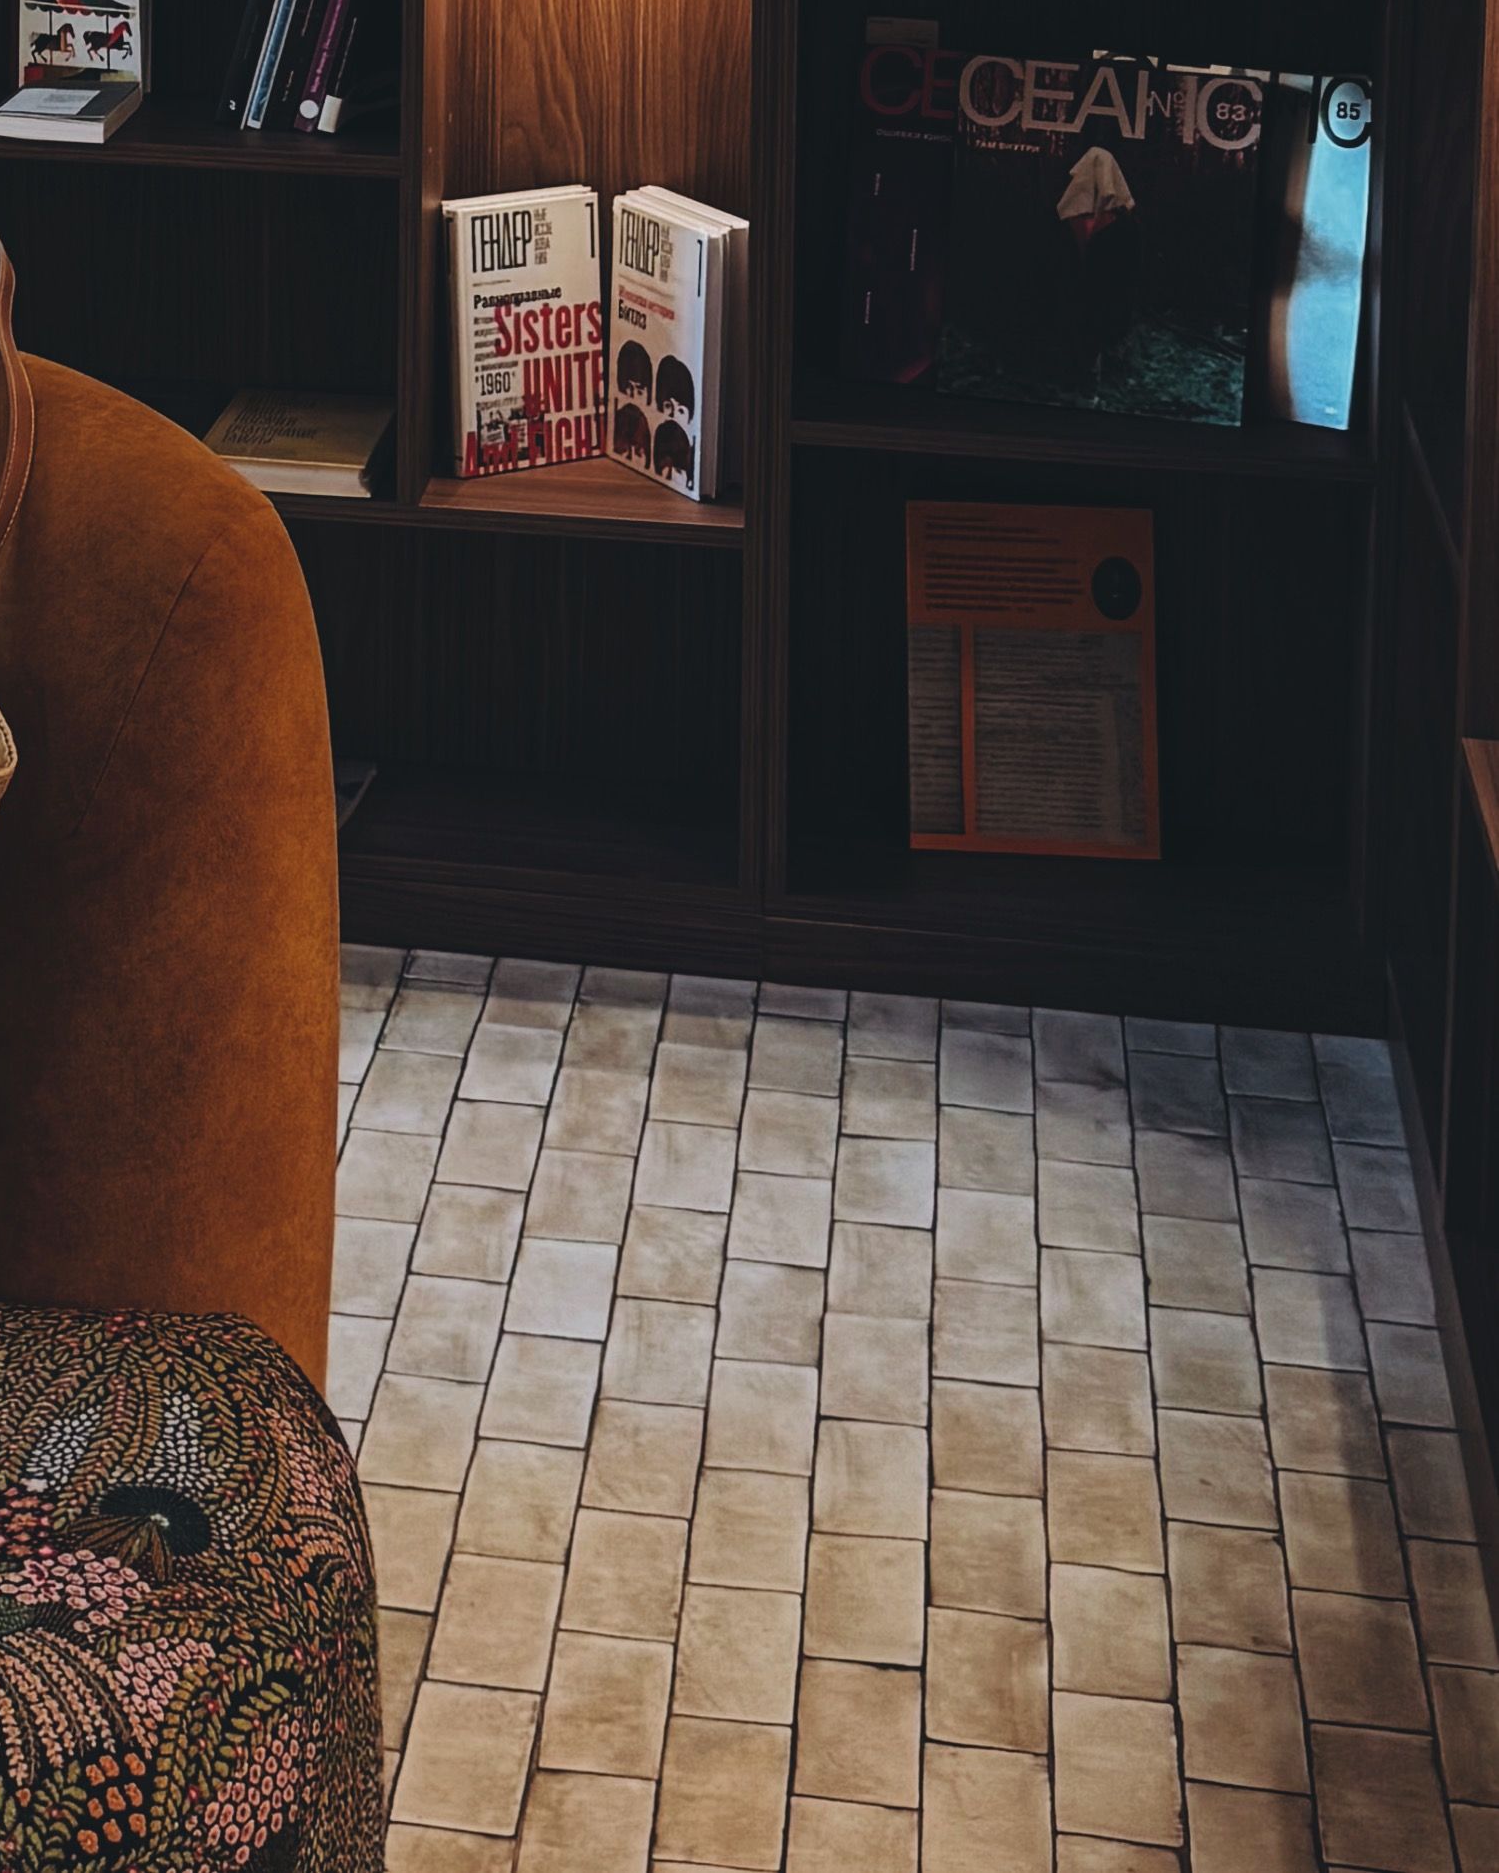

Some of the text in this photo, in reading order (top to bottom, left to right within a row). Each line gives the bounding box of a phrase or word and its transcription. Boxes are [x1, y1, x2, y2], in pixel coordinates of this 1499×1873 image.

[1214, 102, 1247, 123] 83
[1335, 101, 1363, 121] 85
[471, 210, 533, 273] ГЕНДЕР
[493, 300, 602, 358] Sisters
[523, 349, 603, 417] UNITE
